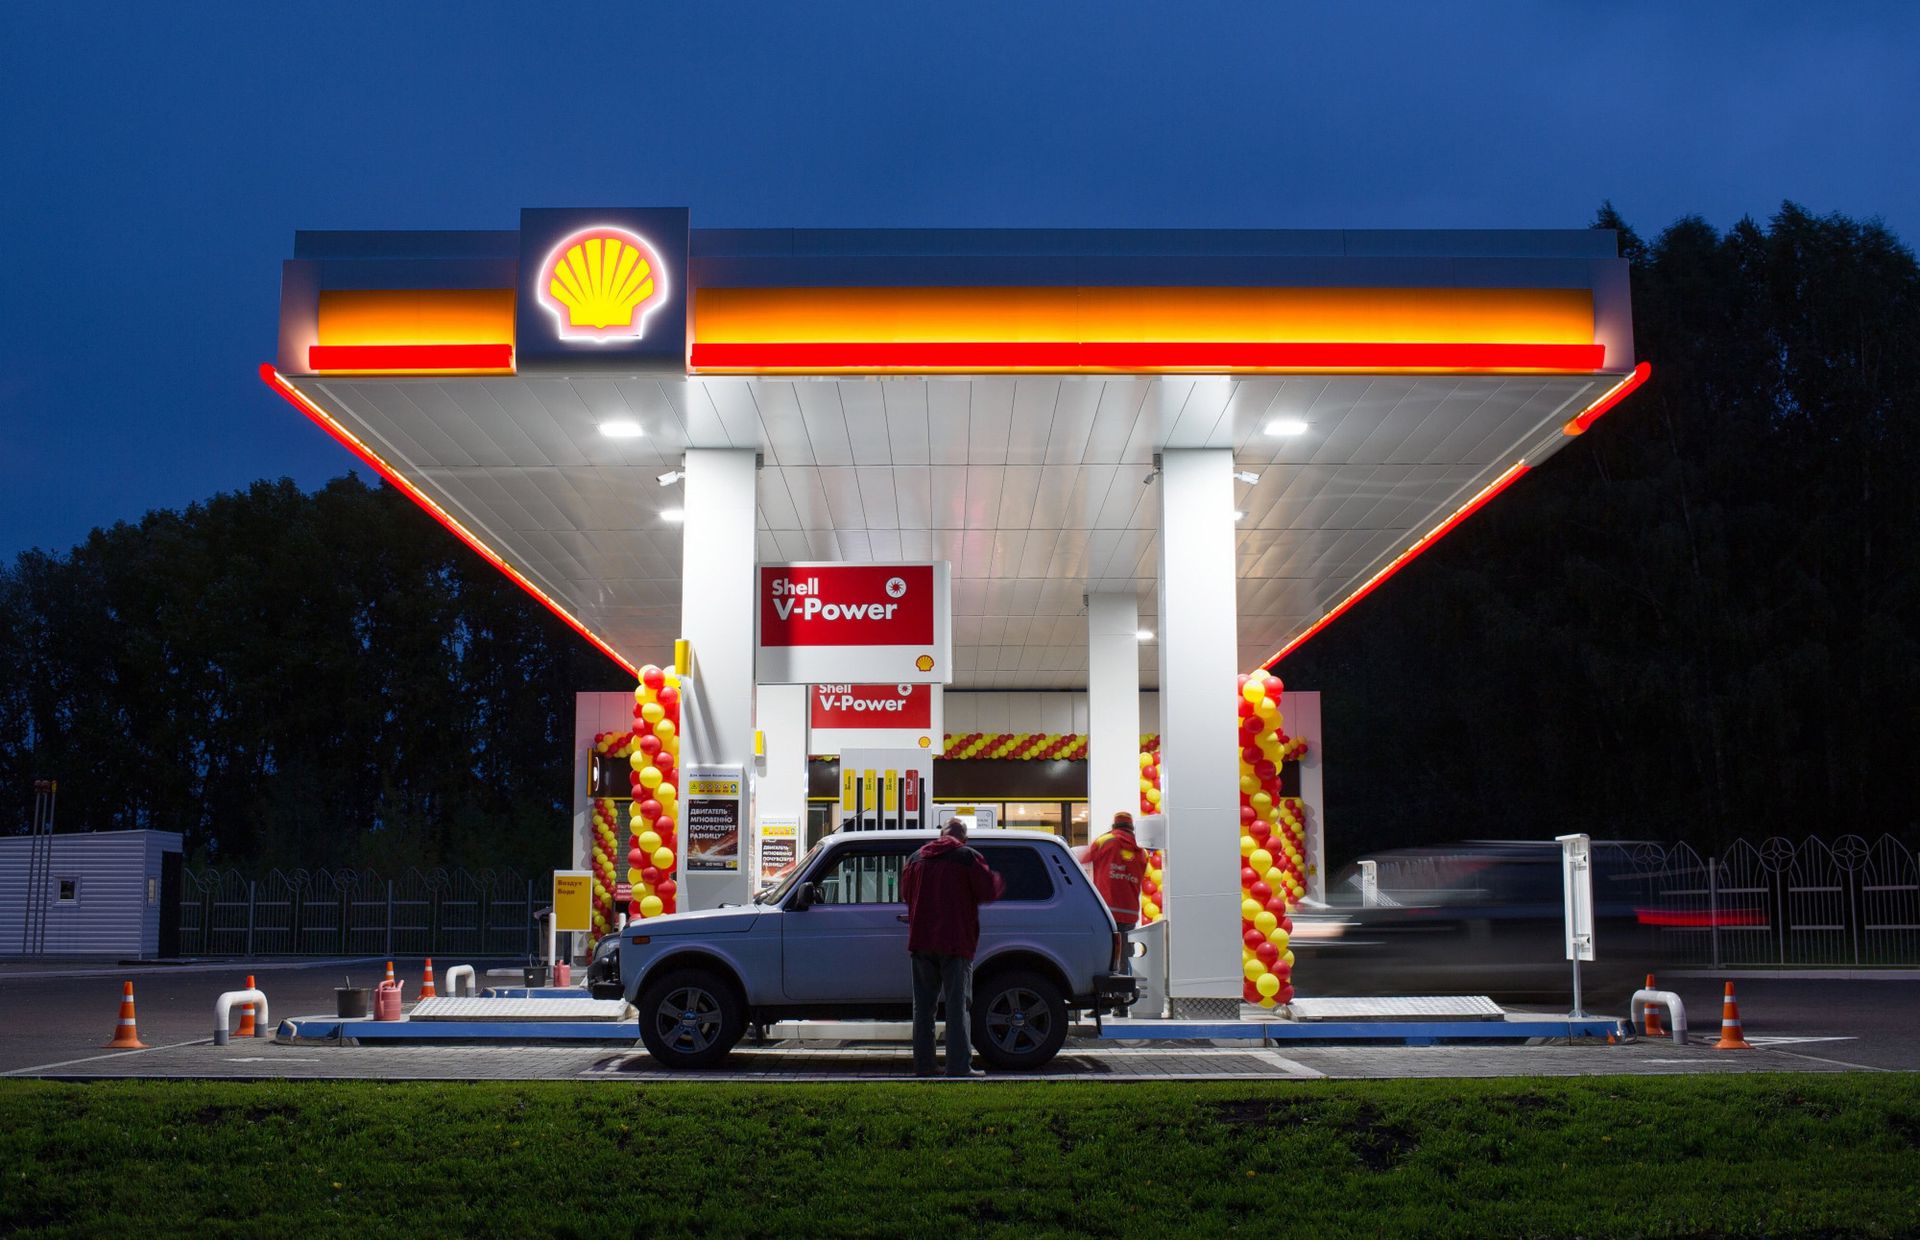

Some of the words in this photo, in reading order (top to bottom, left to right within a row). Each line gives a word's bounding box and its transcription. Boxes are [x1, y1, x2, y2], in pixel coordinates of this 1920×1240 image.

[771, 577, 819, 596] Shell
[772, 597, 898, 621] V-Power
[818, 684, 852, 694] Shell
[819, 695, 906, 711] V-Power
